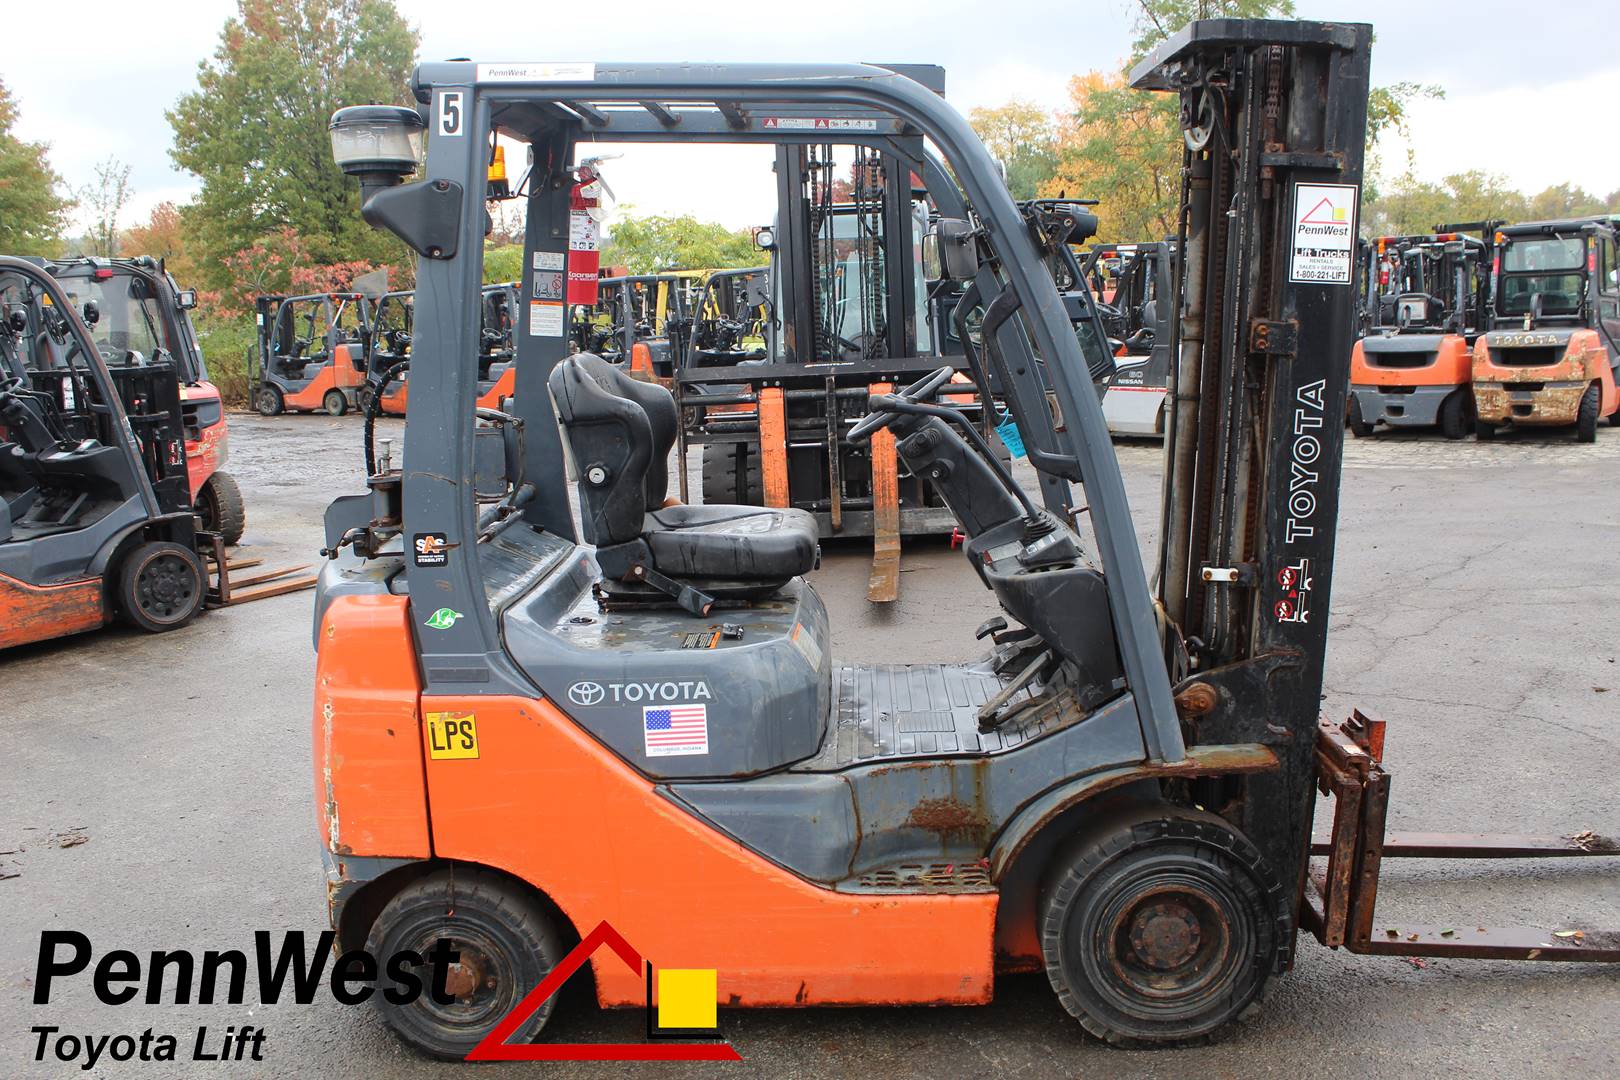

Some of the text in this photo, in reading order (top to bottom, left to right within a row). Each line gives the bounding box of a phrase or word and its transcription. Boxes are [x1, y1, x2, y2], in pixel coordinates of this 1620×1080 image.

[488, 69, 527, 77] PennWest
[443, 94, 460, 134] 5
[1297, 224, 1348, 236] PennWest
[1295, 248, 1350, 258] Lift Trucks
[1296, 270, 1346, 280] 1-800-221-LIFT
[1495, 334, 1558, 346] TOYOTA
[1285, 378, 1326, 544] TOYOTA
[608, 681, 712, 702] TOYOTA
[430, 720, 474, 751] LPS
